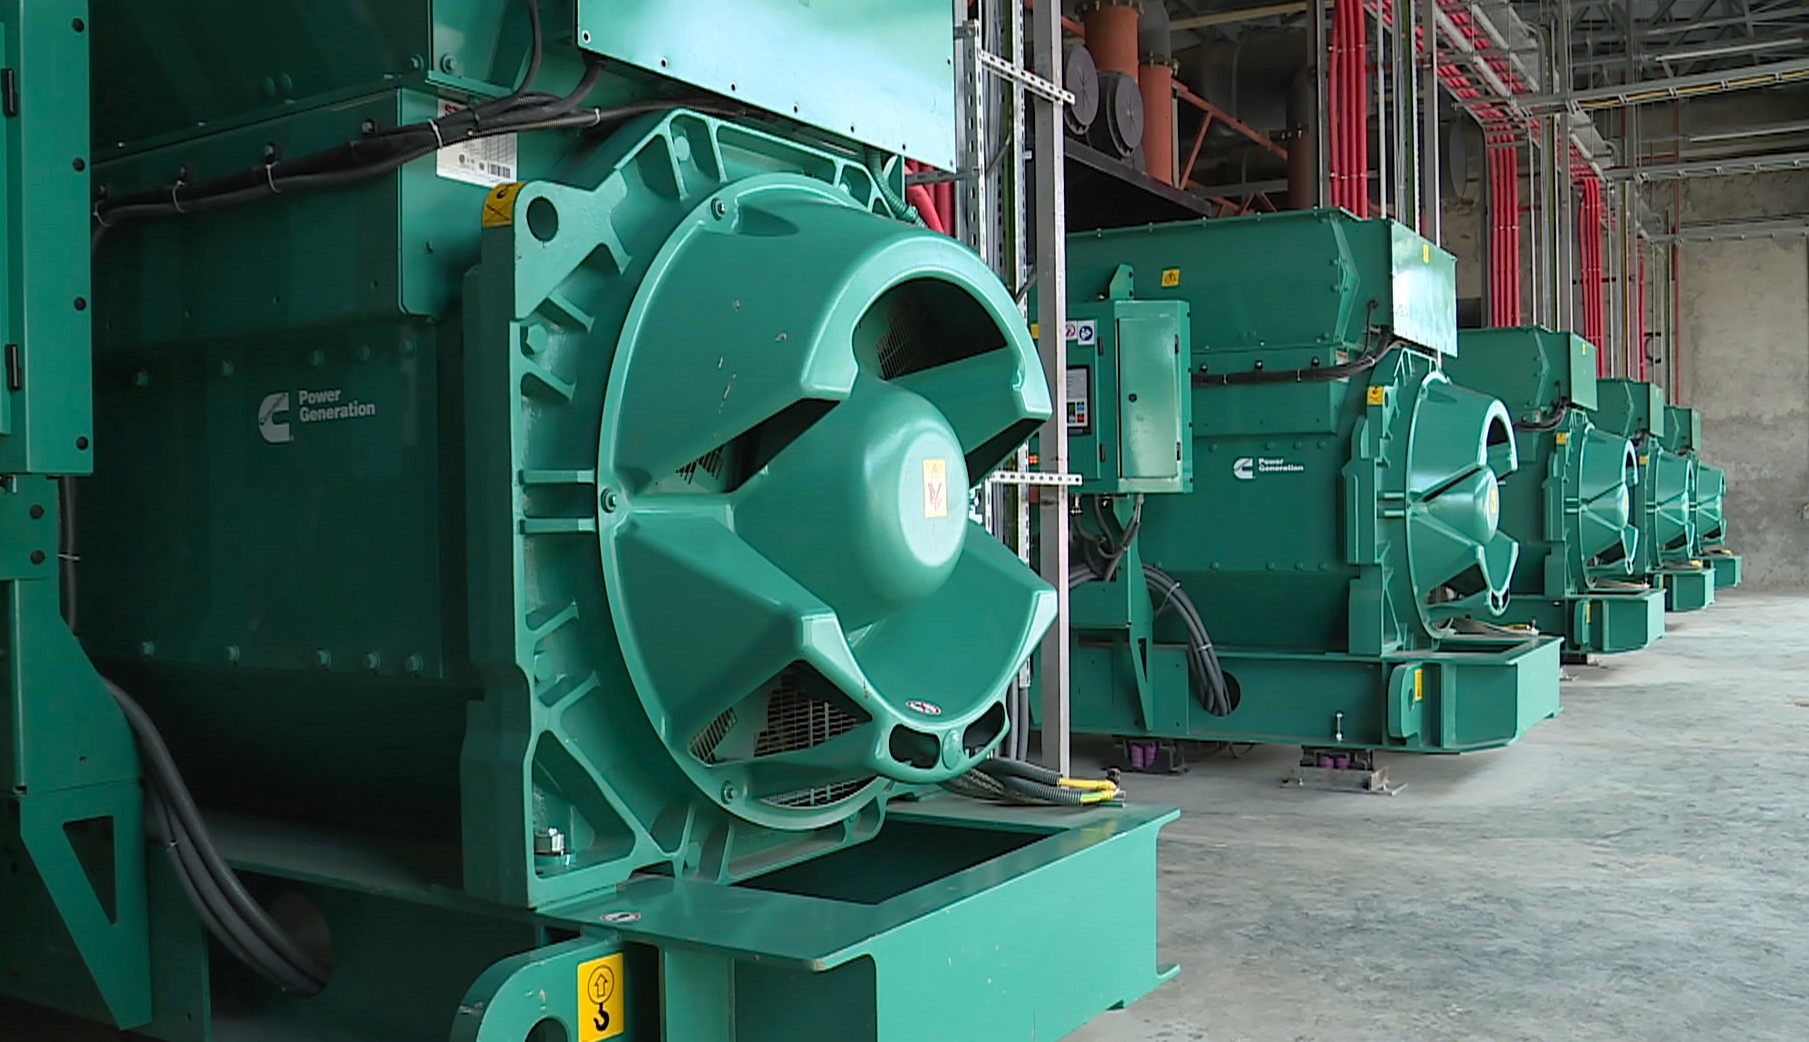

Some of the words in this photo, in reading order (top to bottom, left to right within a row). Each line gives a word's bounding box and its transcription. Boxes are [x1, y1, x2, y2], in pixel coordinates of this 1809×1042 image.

[299, 390, 341, 405] Power
[300, 401, 376, 422] Generation
[1258, 463, 1304, 472] Generation
